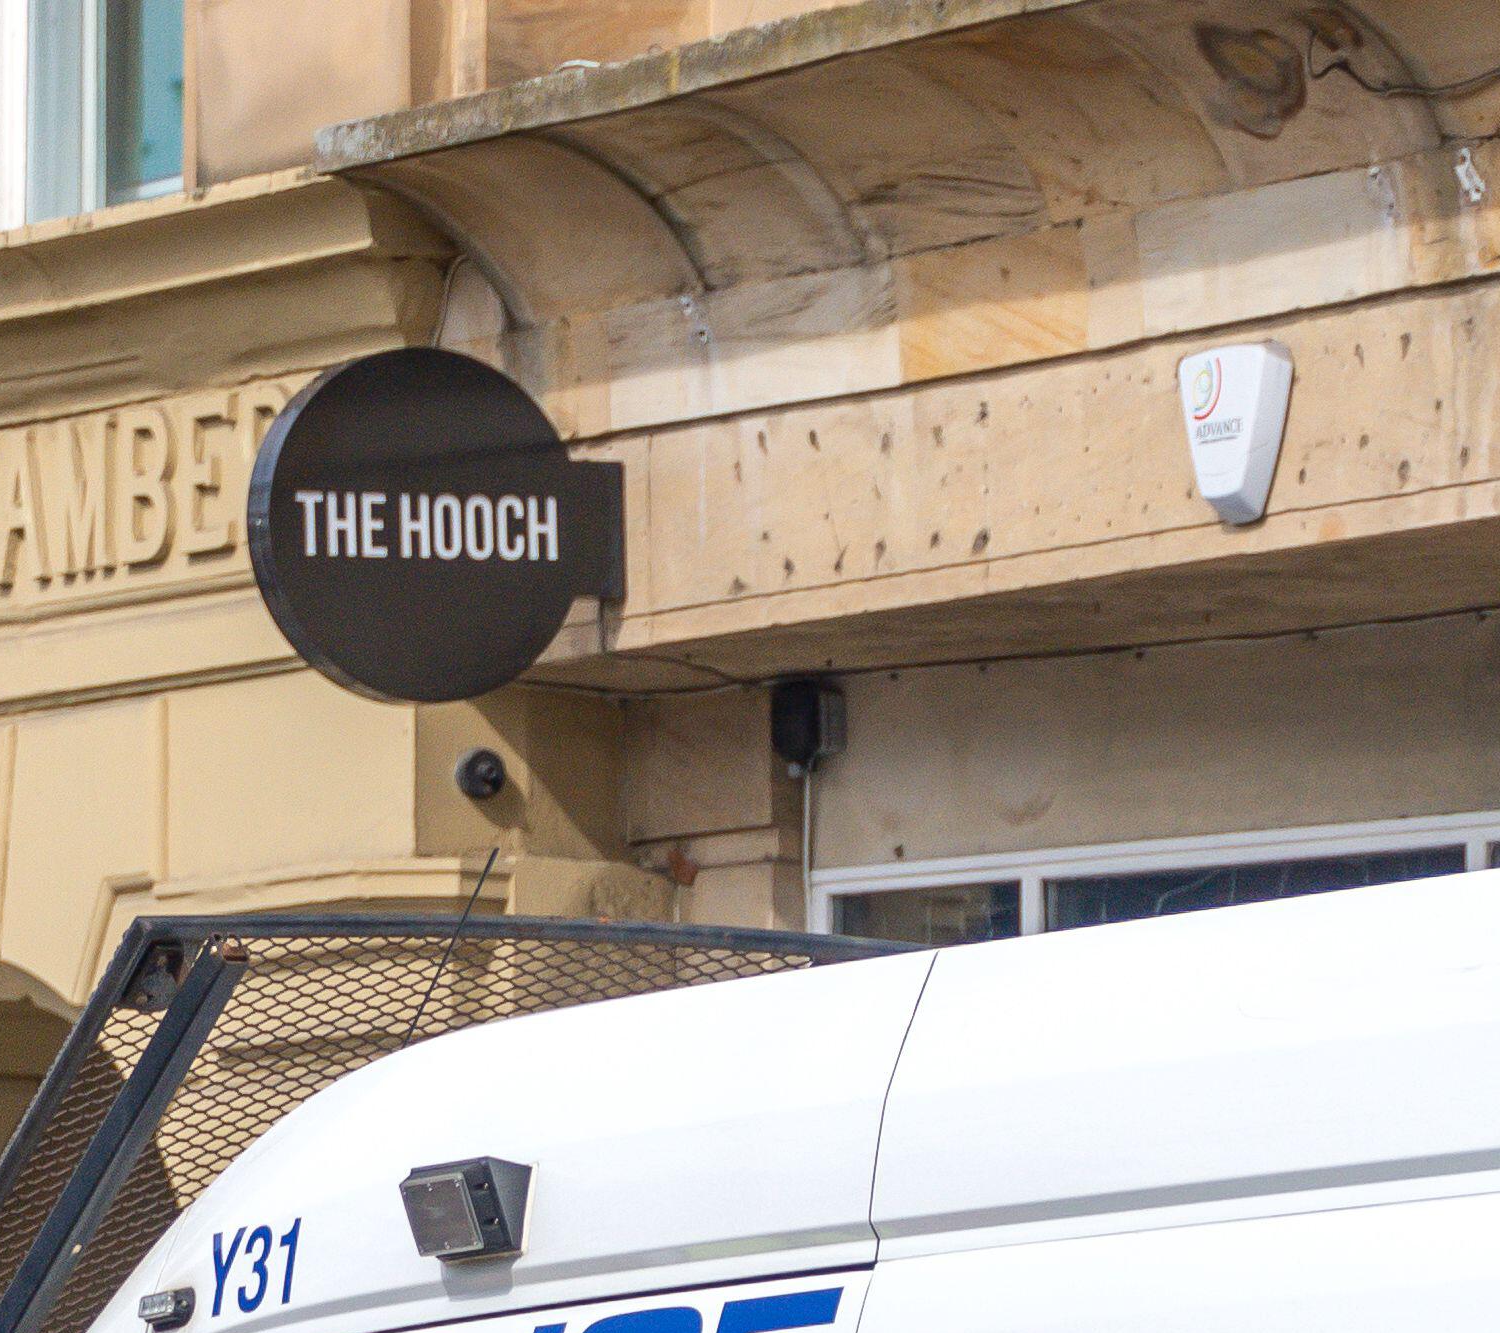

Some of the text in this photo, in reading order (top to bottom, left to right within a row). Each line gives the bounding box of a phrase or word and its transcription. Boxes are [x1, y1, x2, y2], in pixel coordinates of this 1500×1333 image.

[295, 491, 559, 562] THE HOOCH
[211, 1217, 302, 1317] Y31
